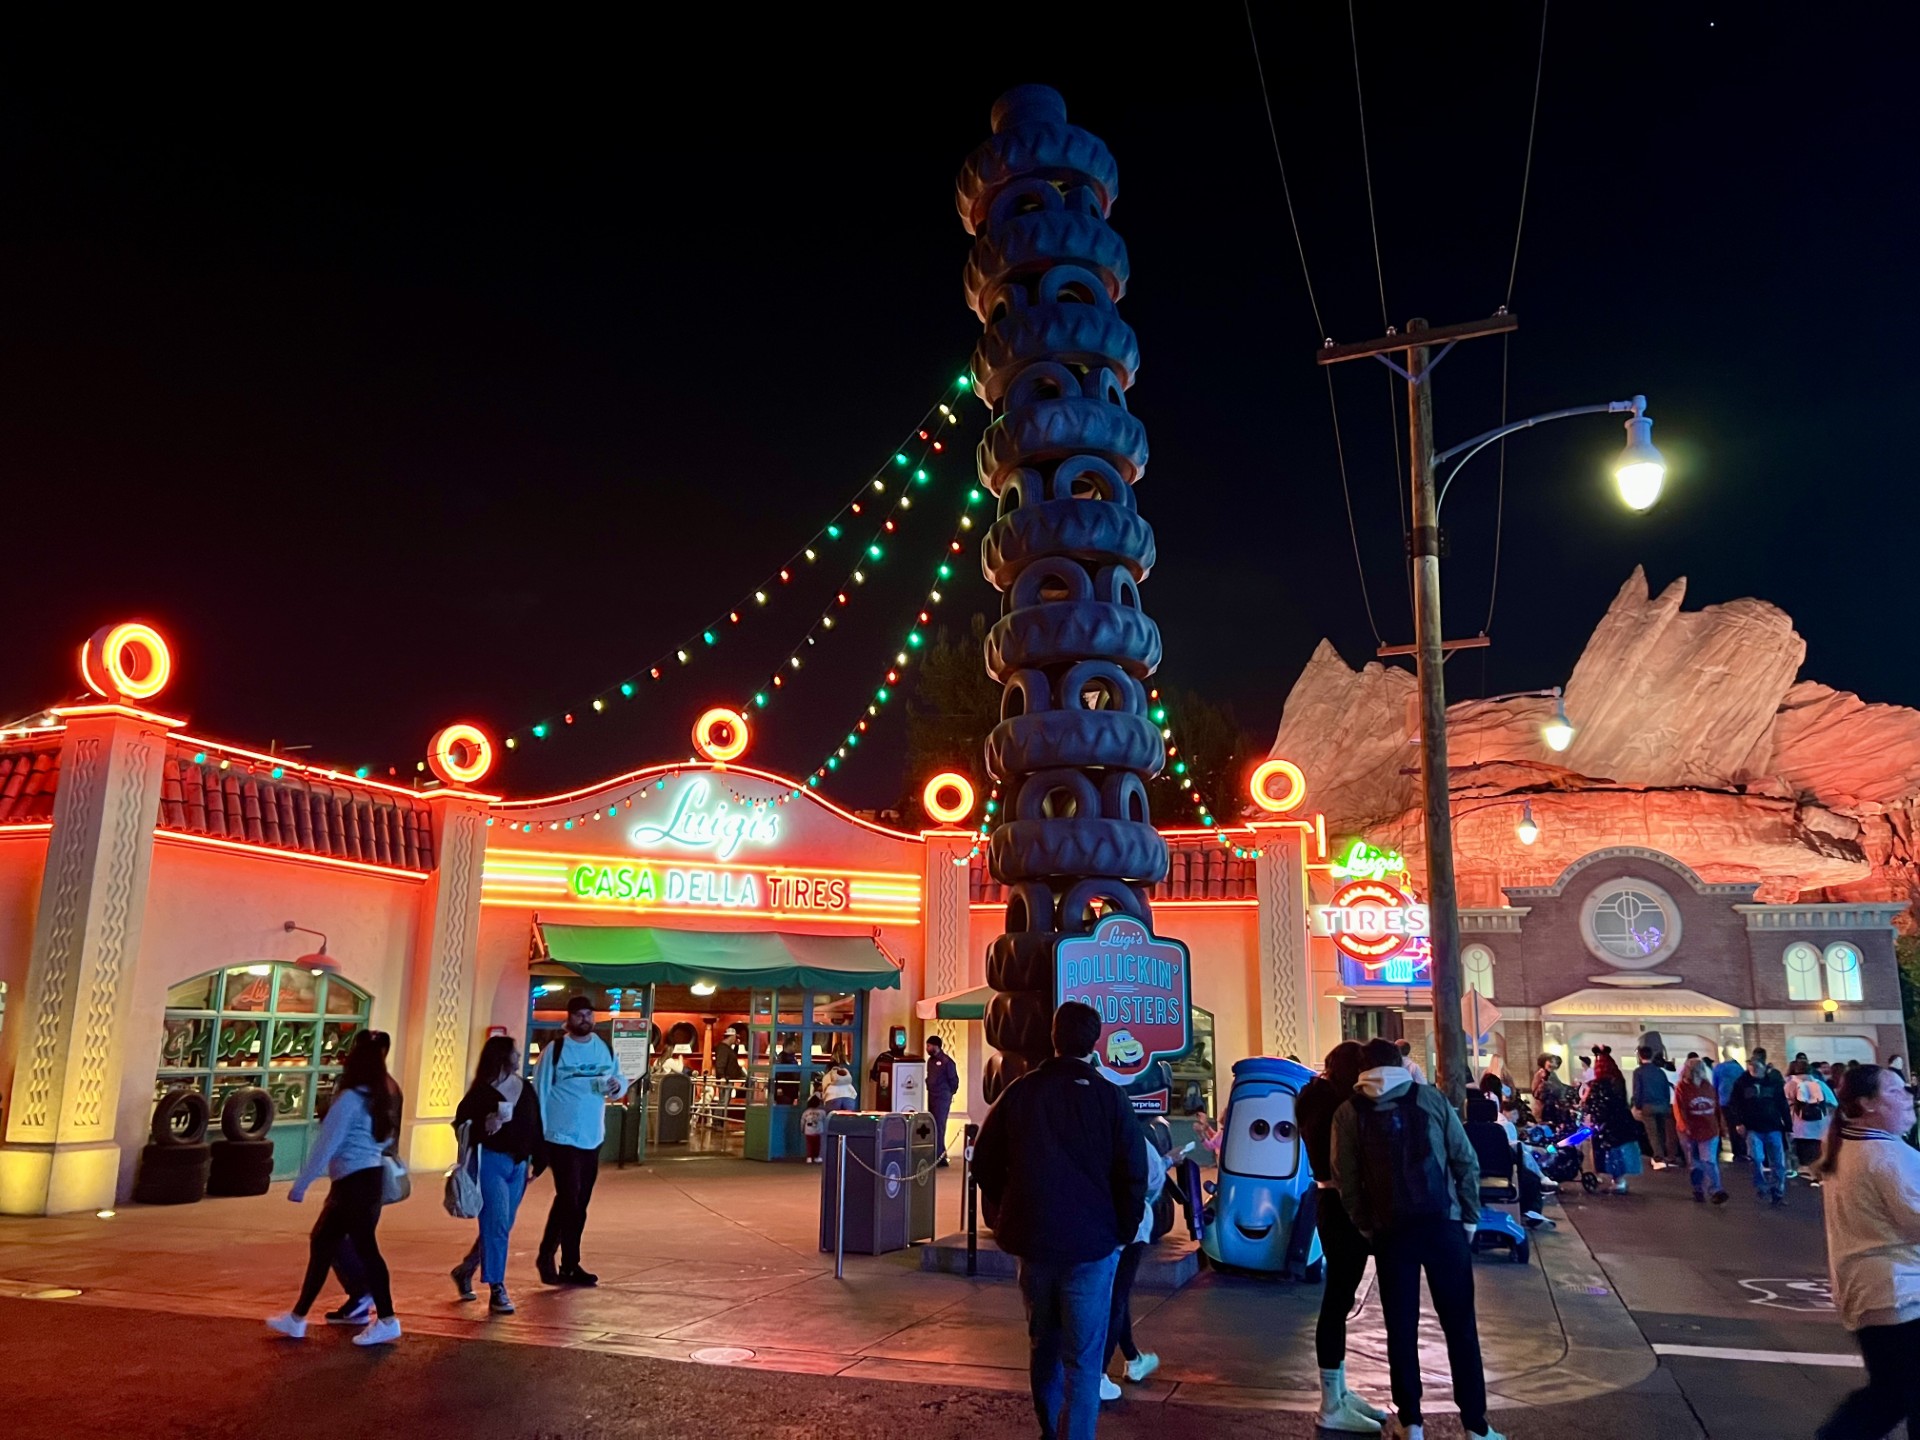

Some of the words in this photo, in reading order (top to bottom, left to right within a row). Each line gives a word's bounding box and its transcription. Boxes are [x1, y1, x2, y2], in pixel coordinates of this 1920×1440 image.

[573, 864, 656, 900] CASA
[667, 869, 758, 906] DELLA
[767, 875, 847, 911] TIRES
[1320, 906, 1426, 934] TIRES
[1100, 925, 1143, 950] Luigi's
[1066, 953, 1180, 989] ROLLICKIN'
[1066, 995, 1180, 1024] ADSTERS
[1567, 1002, 1640, 1012] RADIATOR
[1649, 1002, 1713, 1013] SPRINGS
